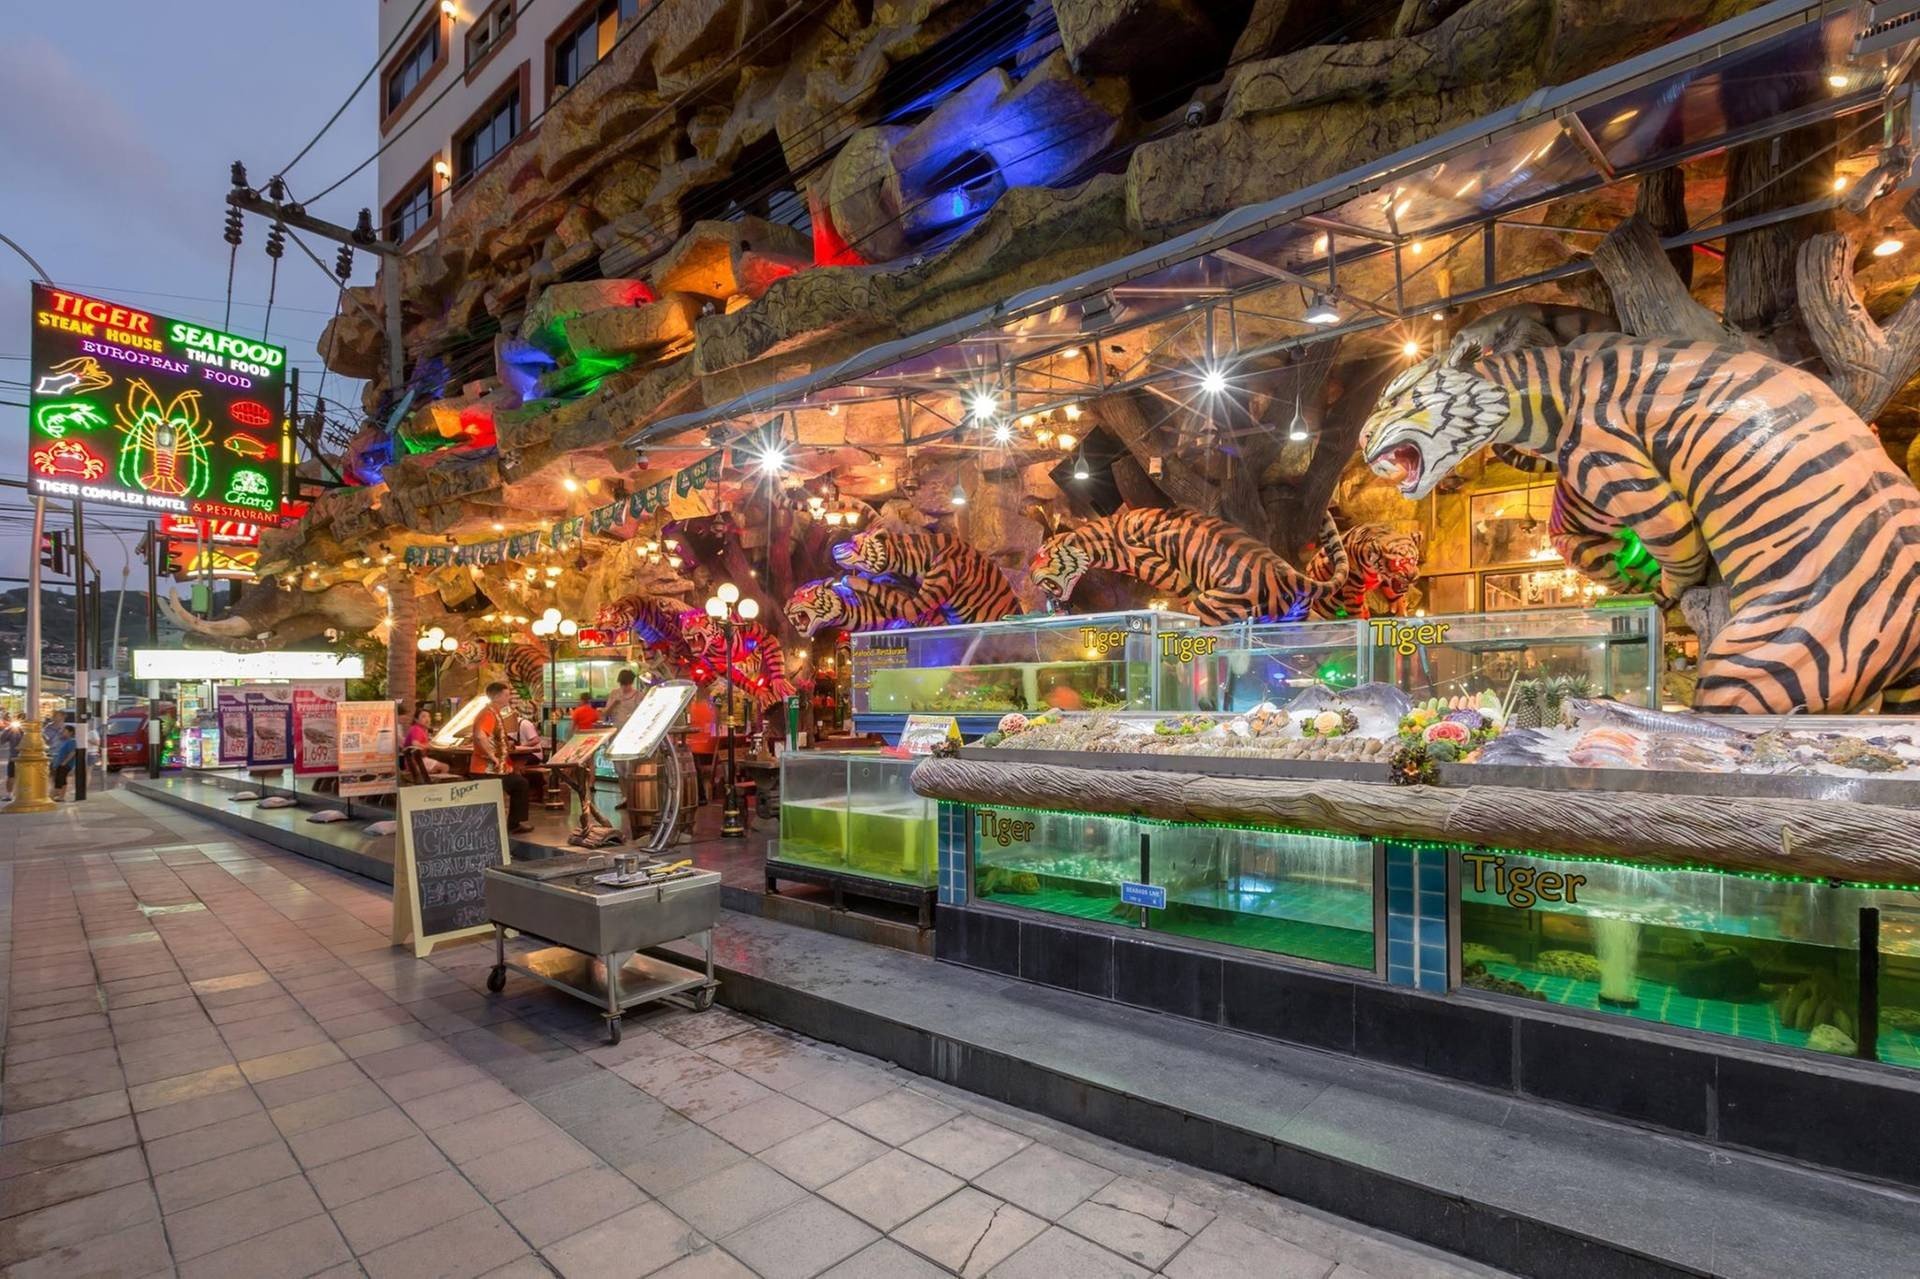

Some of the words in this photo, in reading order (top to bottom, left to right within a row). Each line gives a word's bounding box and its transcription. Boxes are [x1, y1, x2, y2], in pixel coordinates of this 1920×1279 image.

[53, 292, 149, 333] TIGER
[38, 311, 95, 336] STEAK
[106, 328, 163, 353] HOUSE
[171, 323, 282, 366] SEAFOOD
[82, 340, 189, 374] EUROPEAN
[204, 368, 252, 388] FOOD
[185, 347, 224, 368] THAI
[230, 358, 271, 377] FOOD
[36, 479, 80, 496] TIGER
[80, 485, 145, 505] COMPLEX
[146, 495, 188, 512] HOTEL
[192, 502, 202, 513] &
[206, 504, 281, 524] RESTAURANT
[225, 490, 274, 512] Chang
[1080, 626, 1129, 654] Tiger
[1157, 632, 1217, 662] Tiger
[1369, 619, 1451, 656] Tiger
[450, 783, 480, 801] Export
[976, 809, 1035, 847] Tiger
[1462, 854, 1587, 908] Tiger
